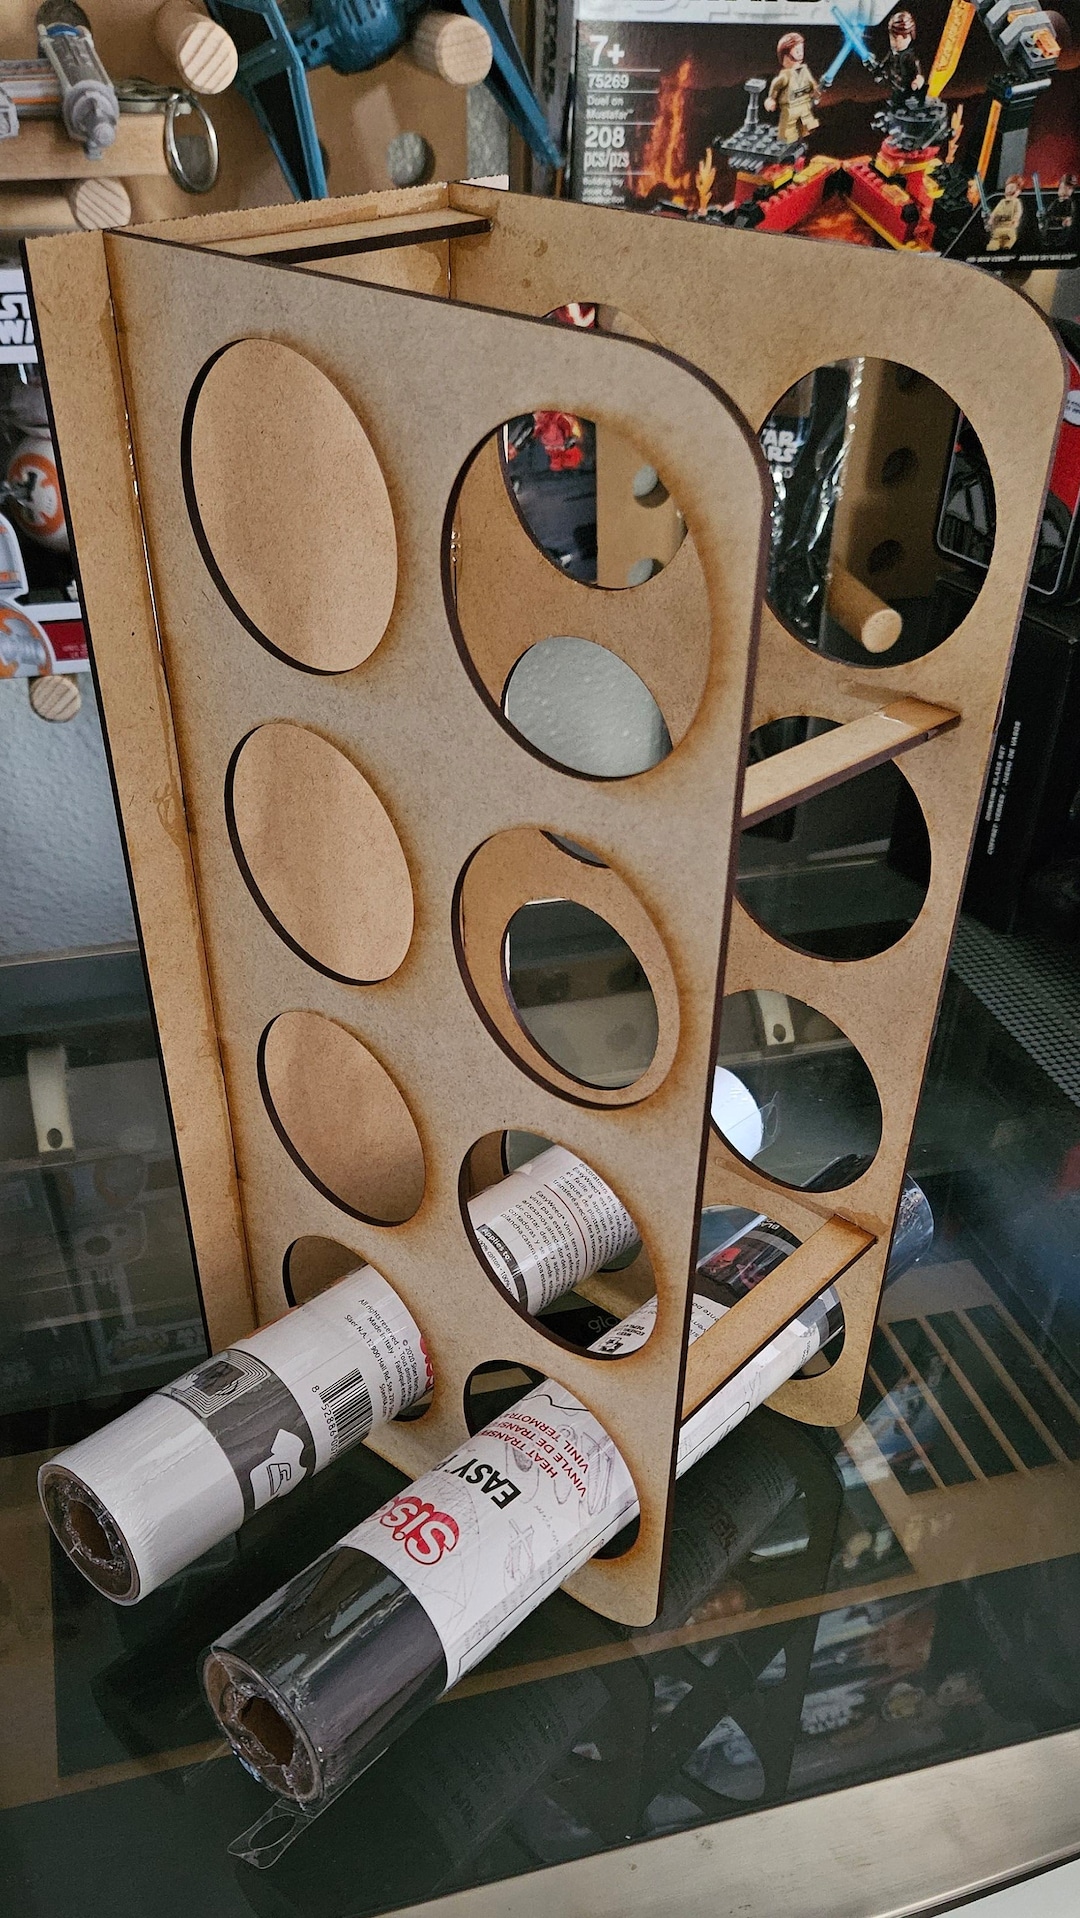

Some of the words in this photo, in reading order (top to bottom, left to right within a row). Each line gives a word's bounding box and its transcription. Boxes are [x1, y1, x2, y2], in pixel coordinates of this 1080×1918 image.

[589, 35, 625, 66] 7+
[588, 74, 630, 89] 75269
[587, 96, 608, 106] Duel
[611, 97, 624, 106] on
[585, 126, 626, 148] 208
[583, 149, 630, 172] pcs/pzs
[998, 744, 1006, 760] SET
[560, 1176, 582, 1198] marques
[582, 1199, 588, 1207] de
[574, 1176, 588, 1193] facile
[522, 1200, 547, 1226] artesanos
[529, 1195, 541, 1208] vinil
[541, 1206, 554, 1220] para
[500, 1212, 522, 1235] plancha
[522, 1234, 536, 1256] casera
[564, 1220, 574, 1236] Vinil
[482, 1228, 504, 1252] Applies
[502, 1251, 512, 1262] to:
[508, 1208, 536, 1239] cortadoras
[542, 1256, 552, 1278] puede
[488, 1251, 500, 1268] cotton
[366, 1304, 381, 1320] rights
[380, 1319, 399, 1346] reserved
[367, 1316, 382, 1333] Made
[384, 1338, 394, 1354] Italy
[344, 1314, 358, 1328] Siser
[356, 1326, 368, 1340] N.A.
[378, 1357, 387, 1372] Hall
[405, 1346, 415, 1362] 2020
[536, 1438, 555, 1454] DE
[564, 1440, 588, 1474] VINIL
[526, 1450, 558, 1478] HEAT
[553, 1452, 586, 1498] VINYLE
